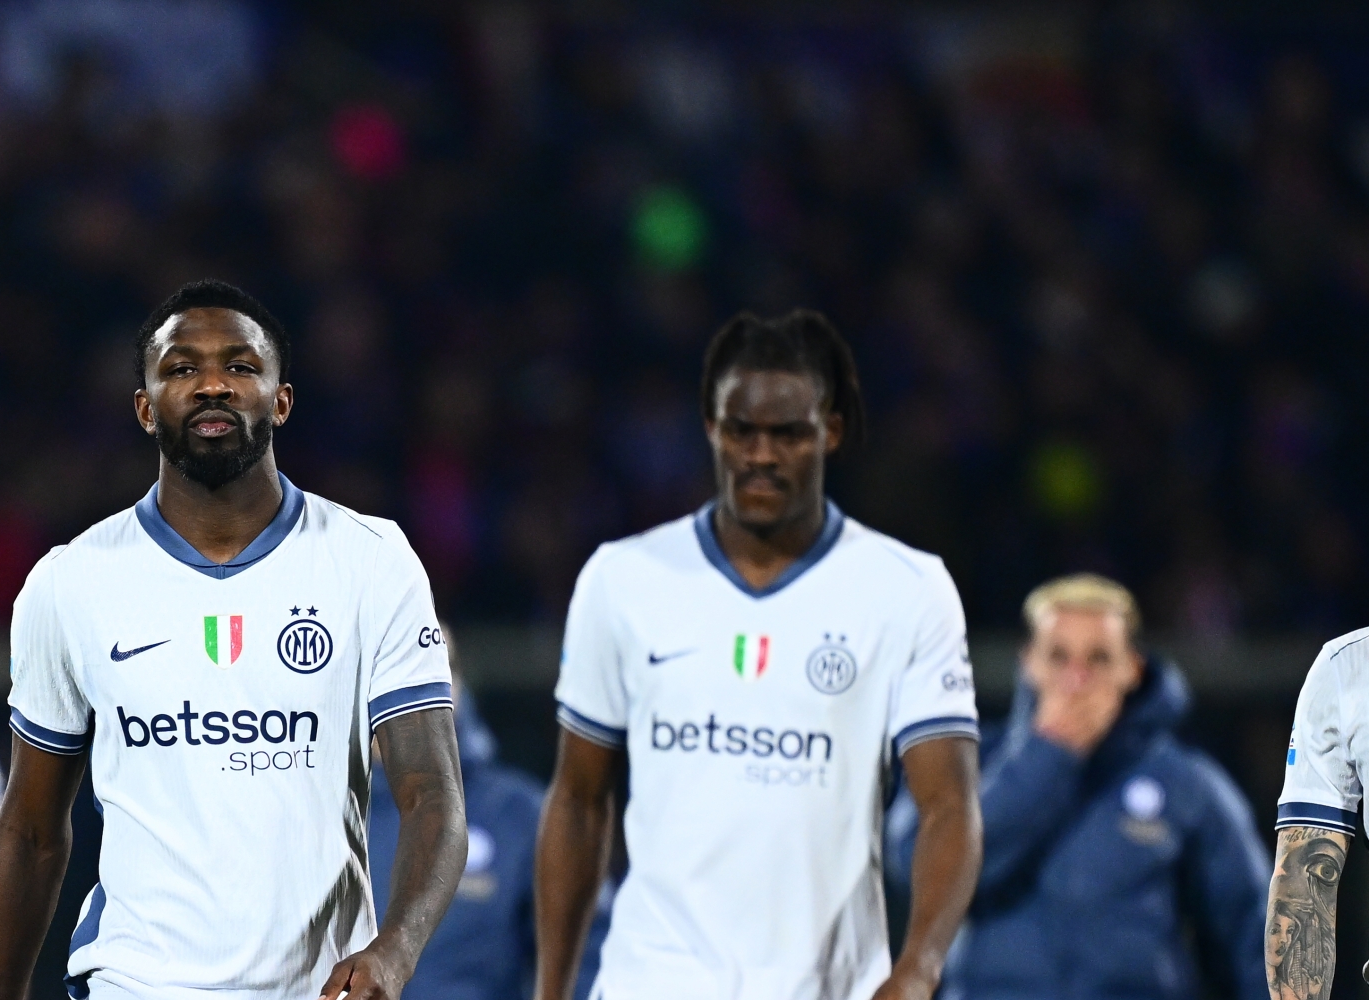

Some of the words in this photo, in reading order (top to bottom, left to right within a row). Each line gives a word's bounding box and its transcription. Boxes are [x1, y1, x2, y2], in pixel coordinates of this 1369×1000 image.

[116, 700, 319, 748] betsson
[651, 712, 833, 762] betsson
[221, 744, 316, 777] .sport
